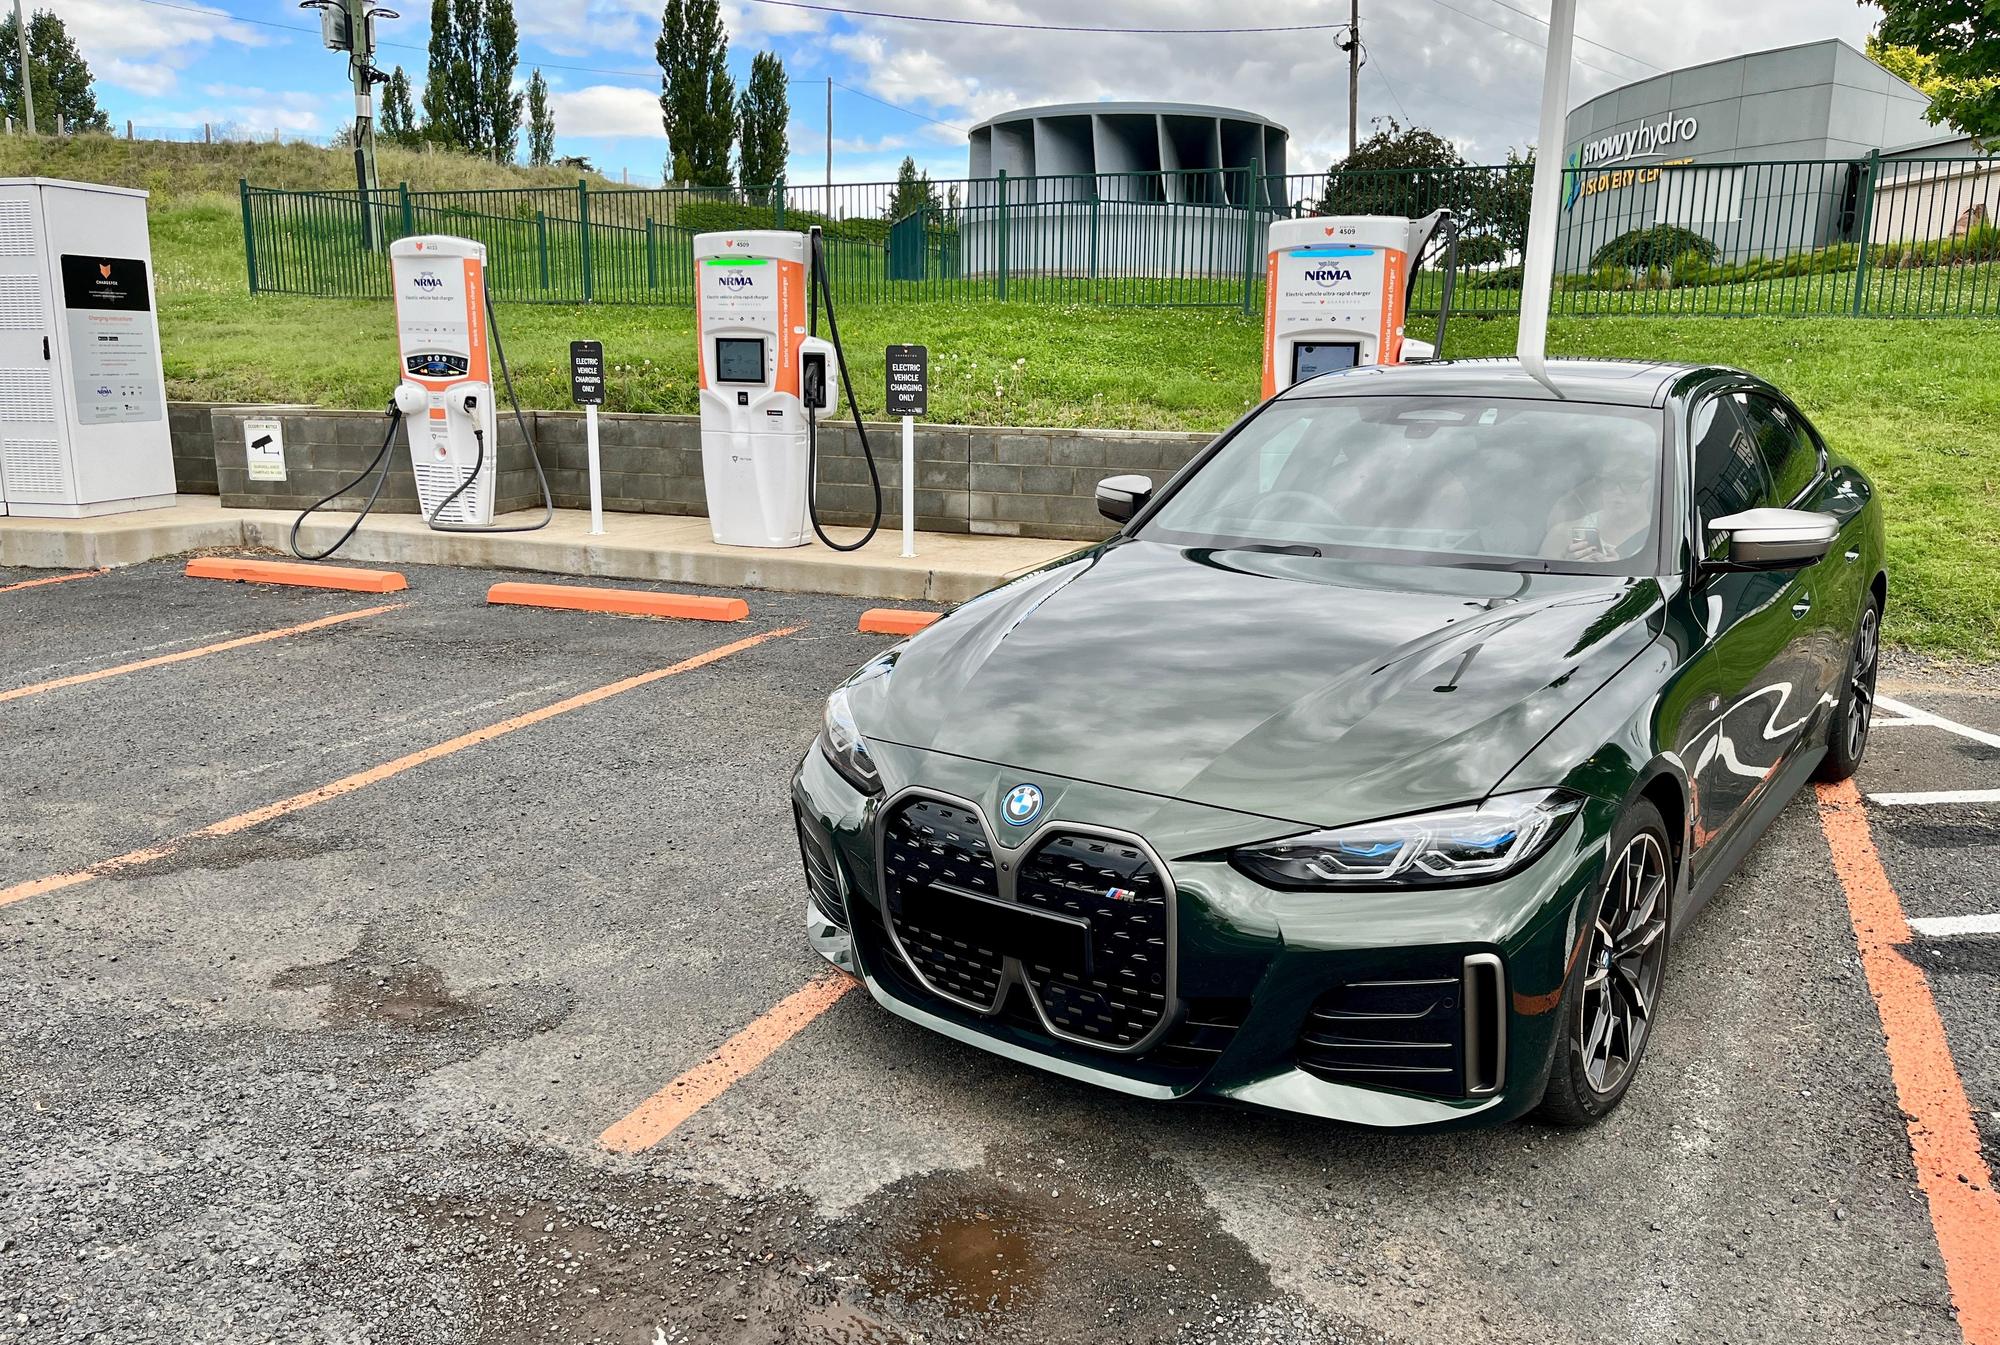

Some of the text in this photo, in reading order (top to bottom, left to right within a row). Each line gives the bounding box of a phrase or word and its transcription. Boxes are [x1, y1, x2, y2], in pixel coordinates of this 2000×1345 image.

[1305, 270, 1351, 280] NRMA
[414, 279, 442, 287] NRMA
[719, 277, 753, 286] NRMA
[575, 357, 599, 365] ELECTRIC
[577, 366, 597, 374] VEHICLE
[892, 363, 920, 371] ELECTRIC
[893, 373, 919, 381] VEHICLE
[890, 383, 922, 391] CHARGING
[898, 393, 915, 401] ONLY
